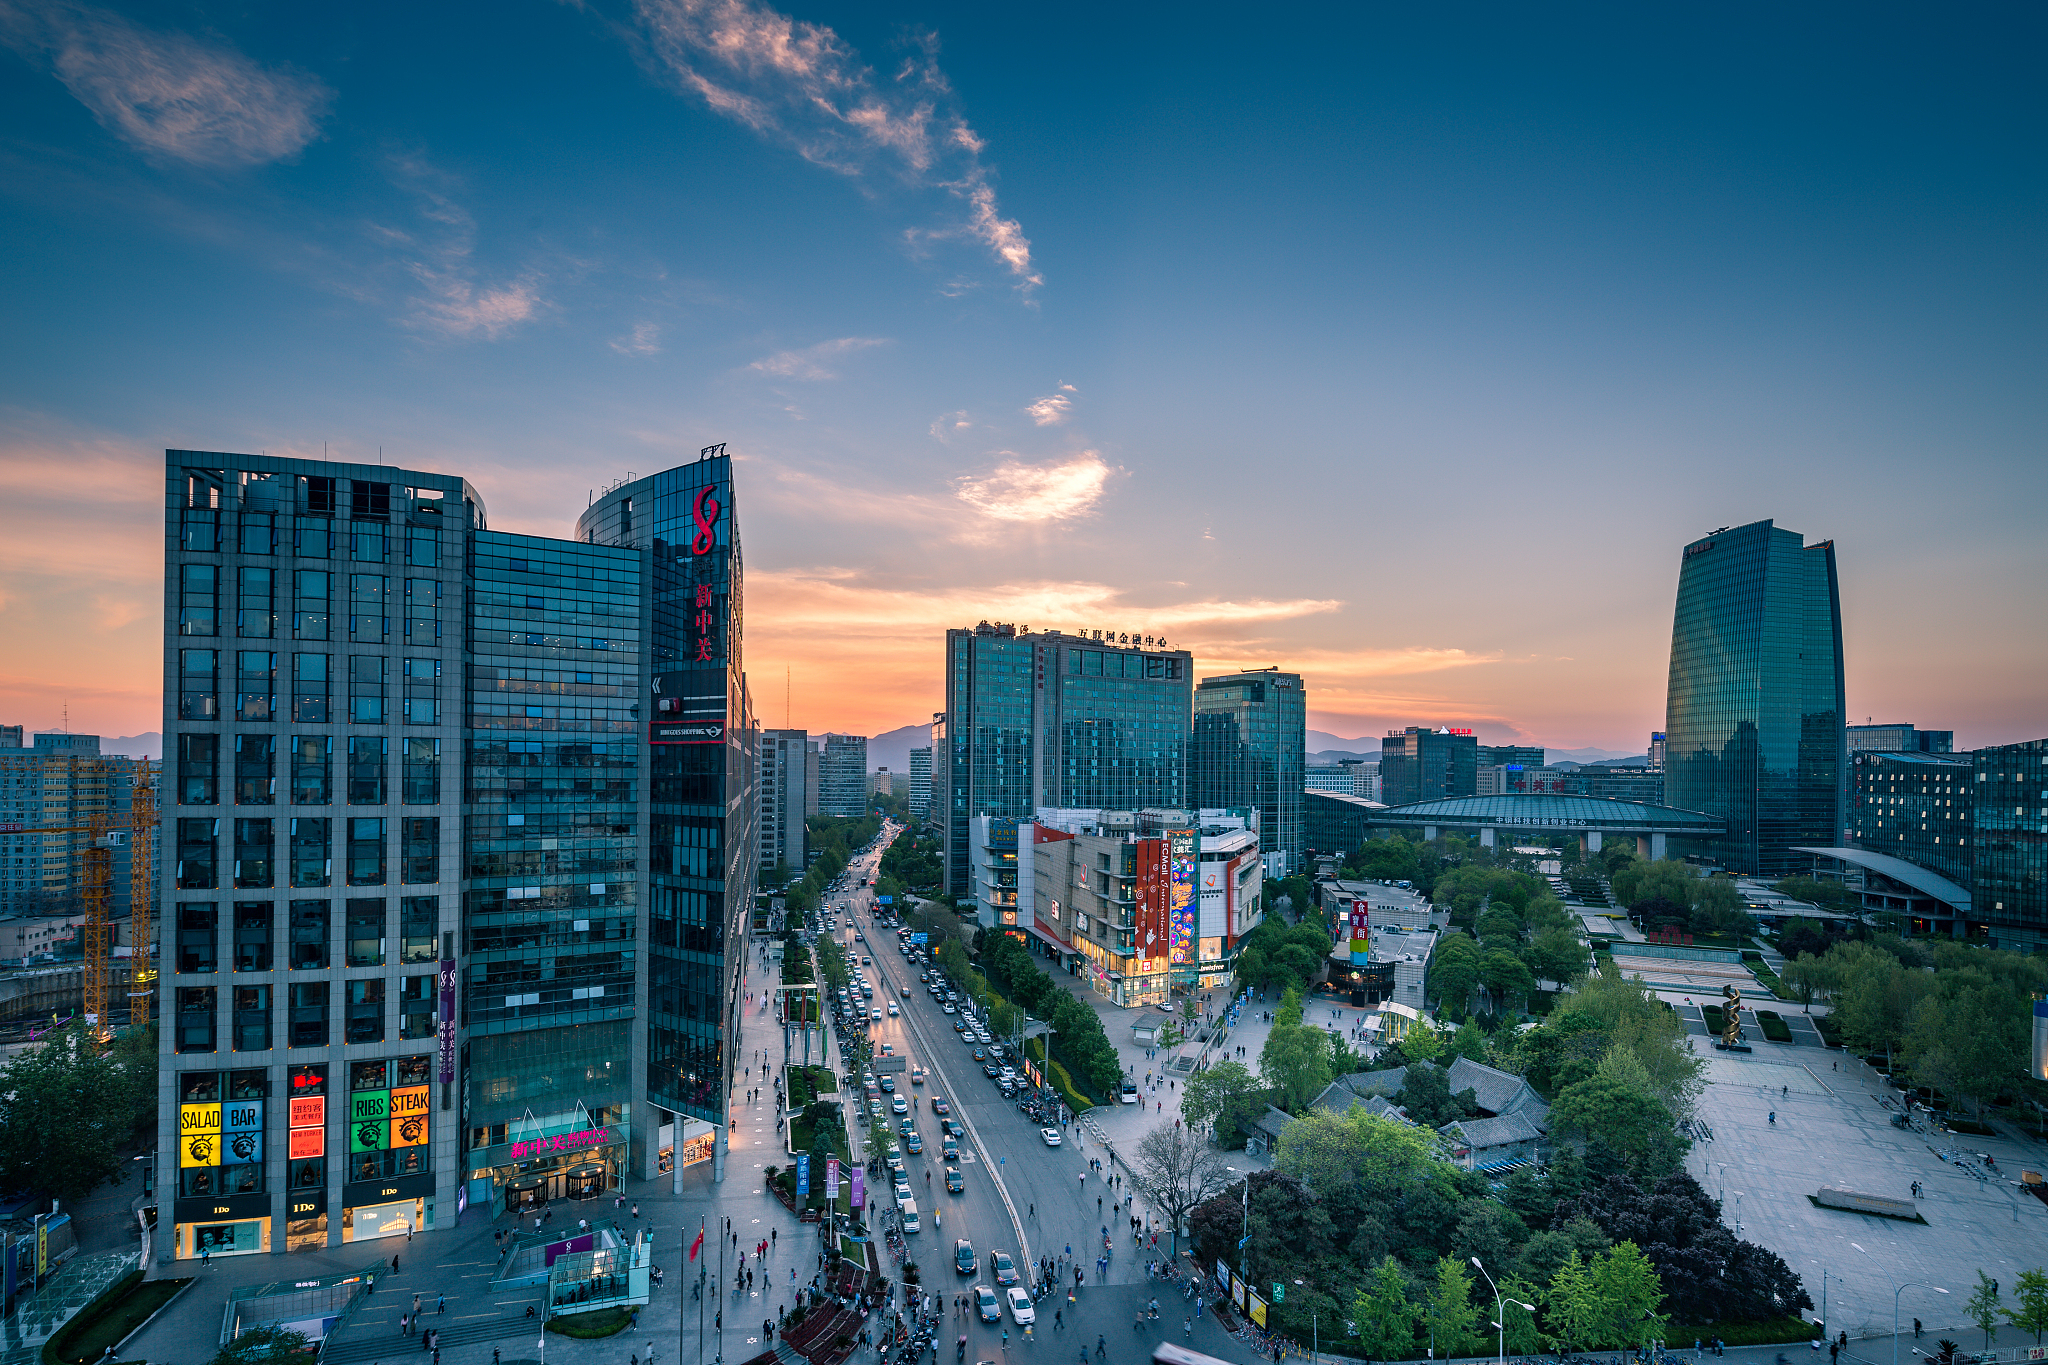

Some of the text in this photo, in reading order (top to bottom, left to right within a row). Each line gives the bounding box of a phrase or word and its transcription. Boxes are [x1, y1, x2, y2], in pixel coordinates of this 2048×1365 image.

[695, 583, 713, 662] 新中关
[1077, 628, 1168, 648] 互联网金融中心
[1514, 779, 1566, 793] 中关村
[1159, 843, 1169, 942] ECMall International
[293, 1104, 322, 1113] 纽约客
[356, 1098, 384, 1117] RIBS
[391, 1092, 429, 1113] STEAK
[182, 1110, 220, 1130] SALAD
[231, 1108, 256, 1127] BAR
[304, 1129, 322, 1137] YORKER
[511, 1127, 609, 1159] 新中关 购物中心
[568, 1137, 609, 1149] CITY MALL
[219, 1206, 230, 1214] Do
[300, 1203, 315, 1212] Do
